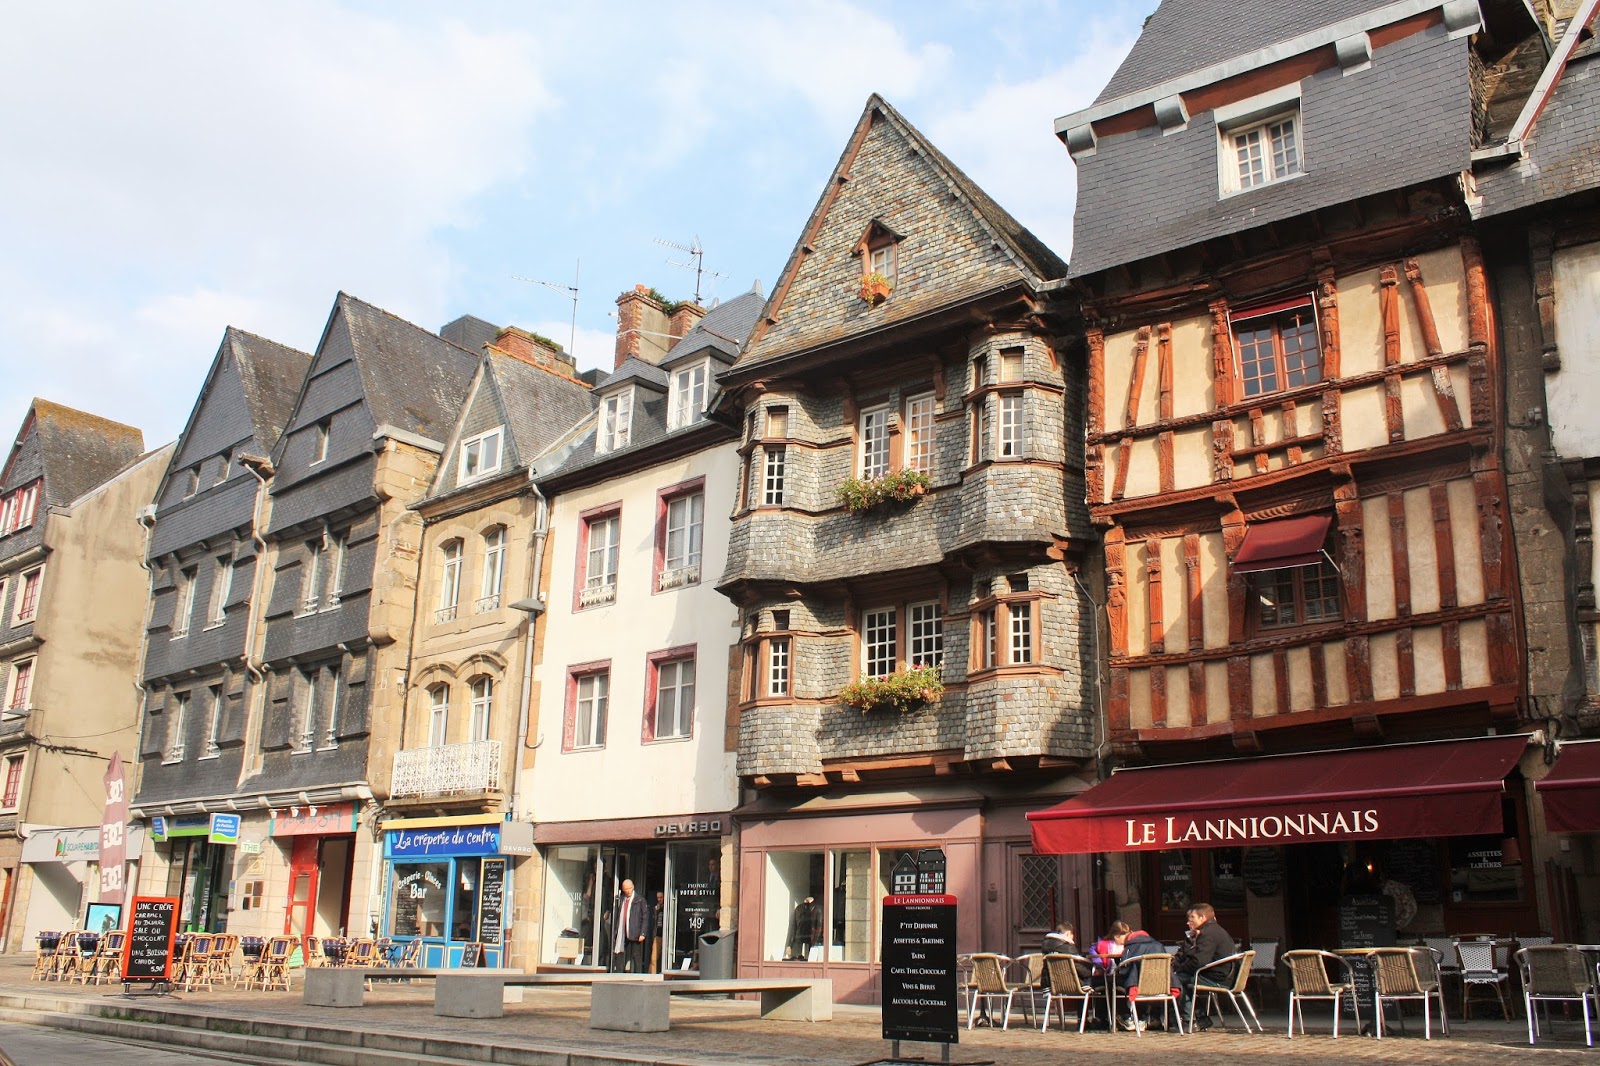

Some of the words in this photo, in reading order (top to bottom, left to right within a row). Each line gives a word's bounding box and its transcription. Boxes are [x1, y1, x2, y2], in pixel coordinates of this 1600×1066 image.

[395, 830, 411, 850] La
[452, 826, 464, 845] du
[409, 882, 428, 899] Bar
